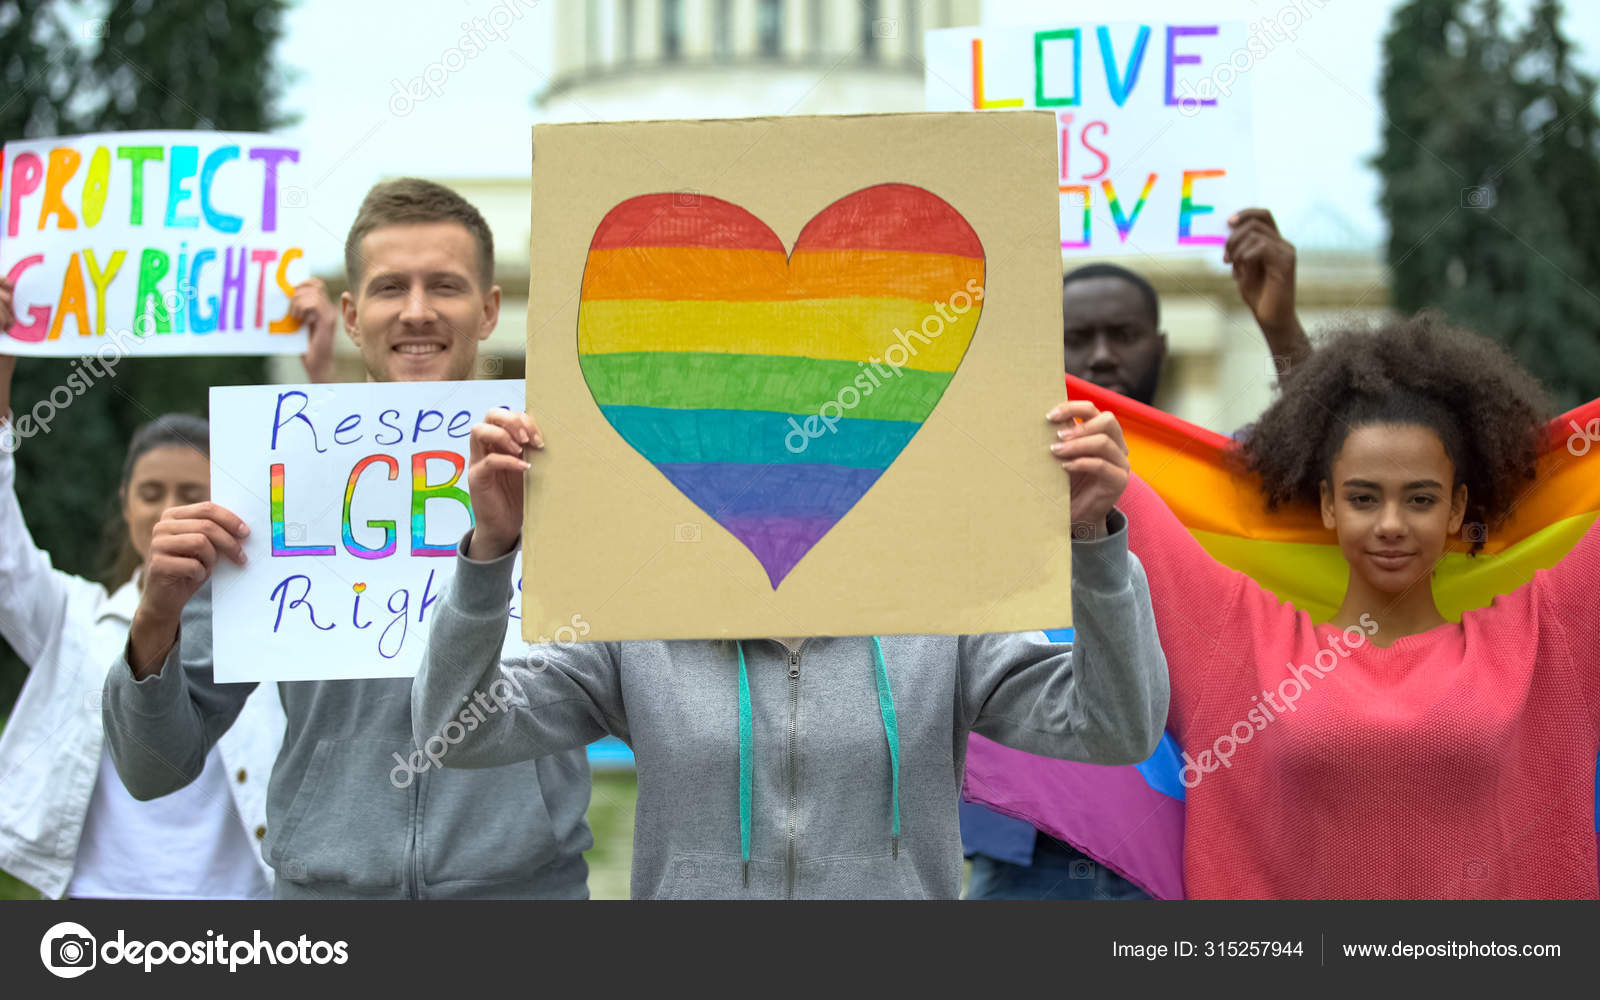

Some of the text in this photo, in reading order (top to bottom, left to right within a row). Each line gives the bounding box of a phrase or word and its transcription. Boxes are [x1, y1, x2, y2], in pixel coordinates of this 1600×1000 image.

[971, 25, 1219, 109] LOVE
[8, 145, 300, 237] PROTECT
[1059, 169, 1227, 248] OVE
[5, 248, 128, 342] GAY
[270, 390, 510, 453] Respe
[269, 450, 476, 559] LGB
